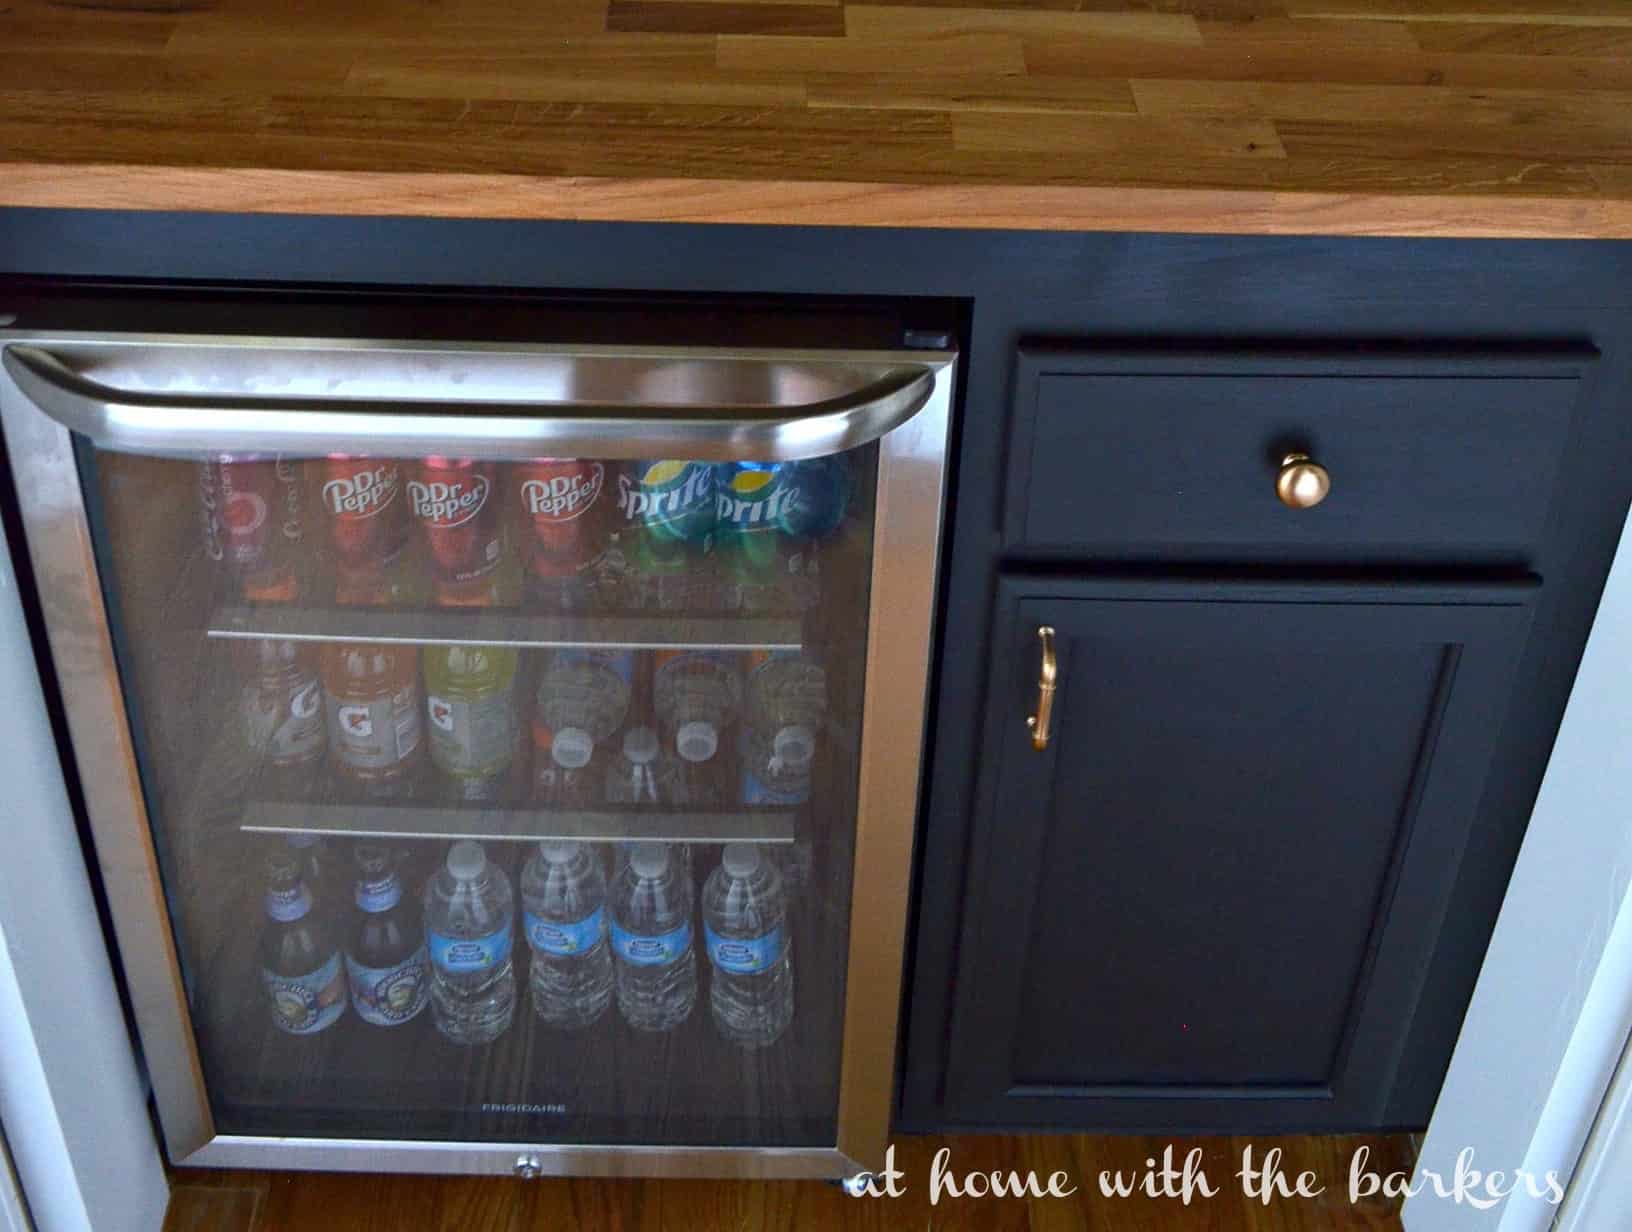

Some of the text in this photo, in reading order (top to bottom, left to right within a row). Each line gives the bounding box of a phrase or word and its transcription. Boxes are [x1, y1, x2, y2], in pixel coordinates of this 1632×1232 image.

[429, 482, 462, 501] Dr
[529, 474, 600, 516] Pepper
[550, 475, 582, 496] Dr
[412, 483, 483, 520] Pepper
